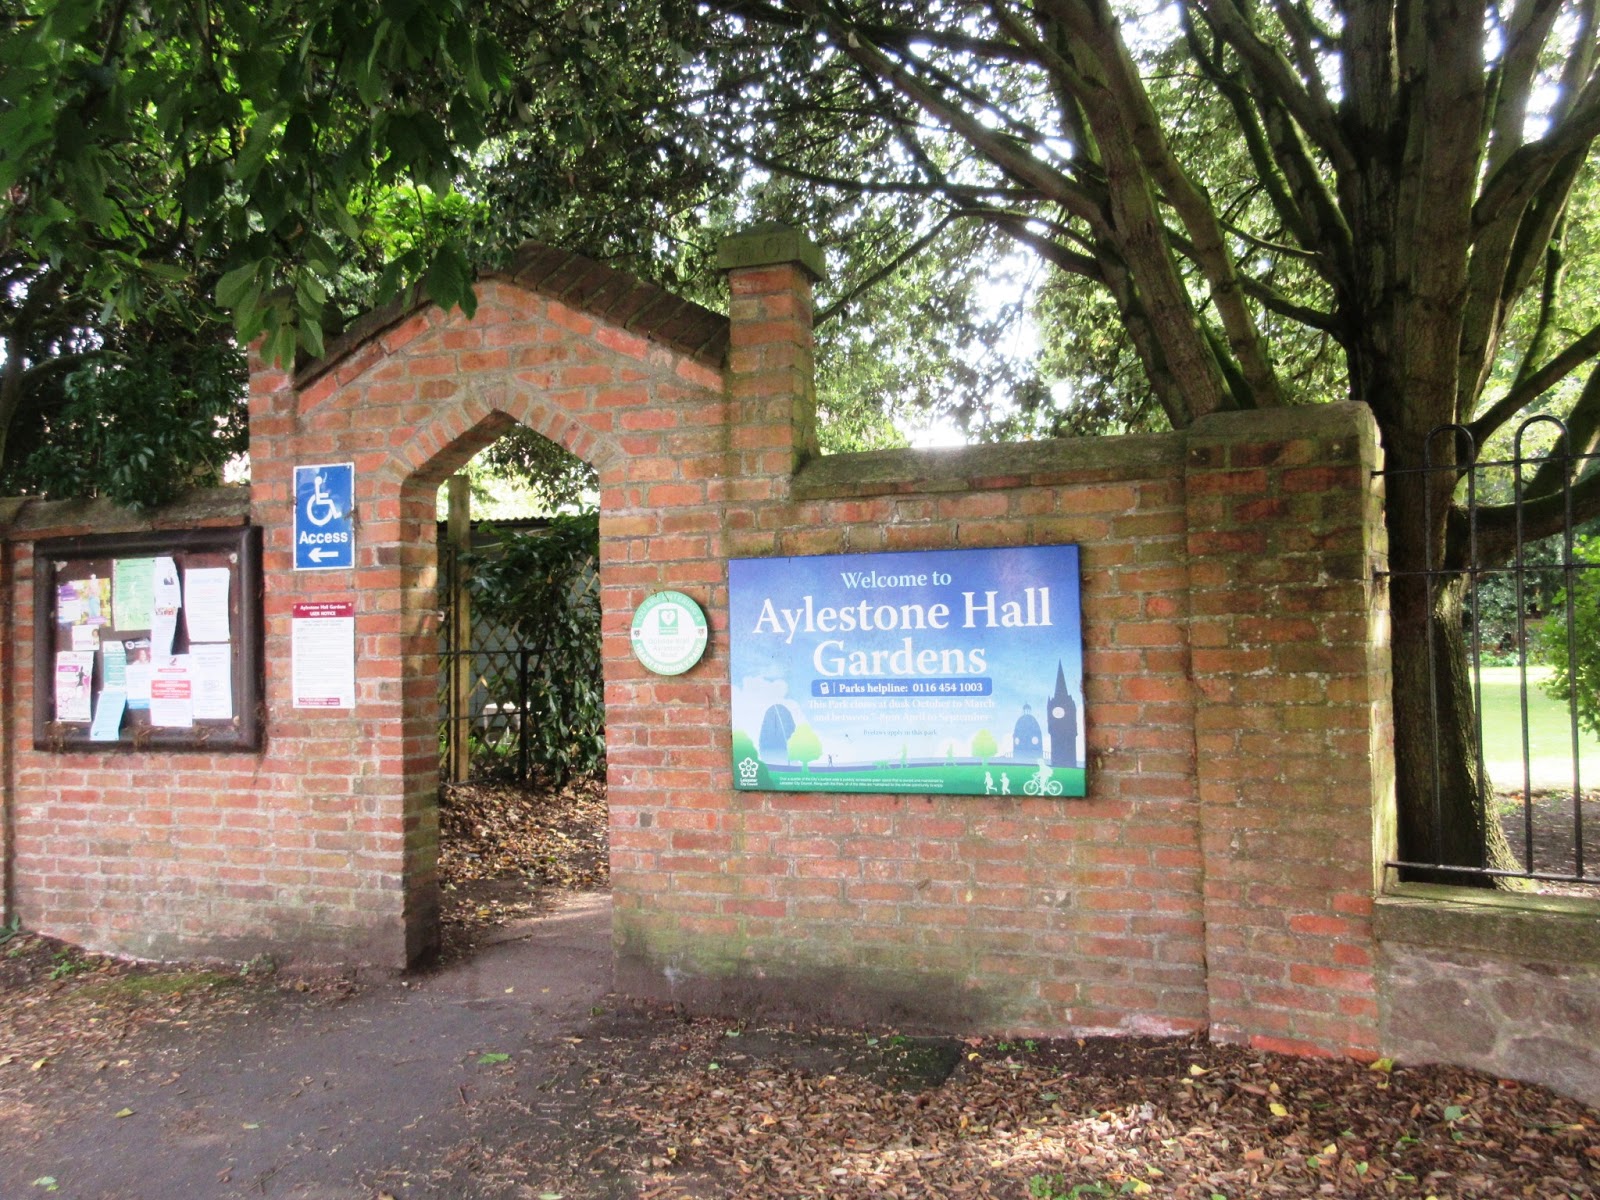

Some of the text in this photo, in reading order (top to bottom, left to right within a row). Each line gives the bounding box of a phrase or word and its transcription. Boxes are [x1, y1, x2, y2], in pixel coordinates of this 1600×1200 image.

[299, 531, 348, 545] Access
[841, 571, 952, 589] Welcome to
[752, 587, 1053, 644] Aylestone Hall
[813, 637, 987, 677] Gardens
[839, 682, 983, 695] Parks helpline: 0116 454 1003
[808, 699, 826, 709] This
[828, 699, 848, 709] Park
[888, 699, 910, 709] dusk
[912, 699, 950, 709] October
[964, 699, 995, 709] March
